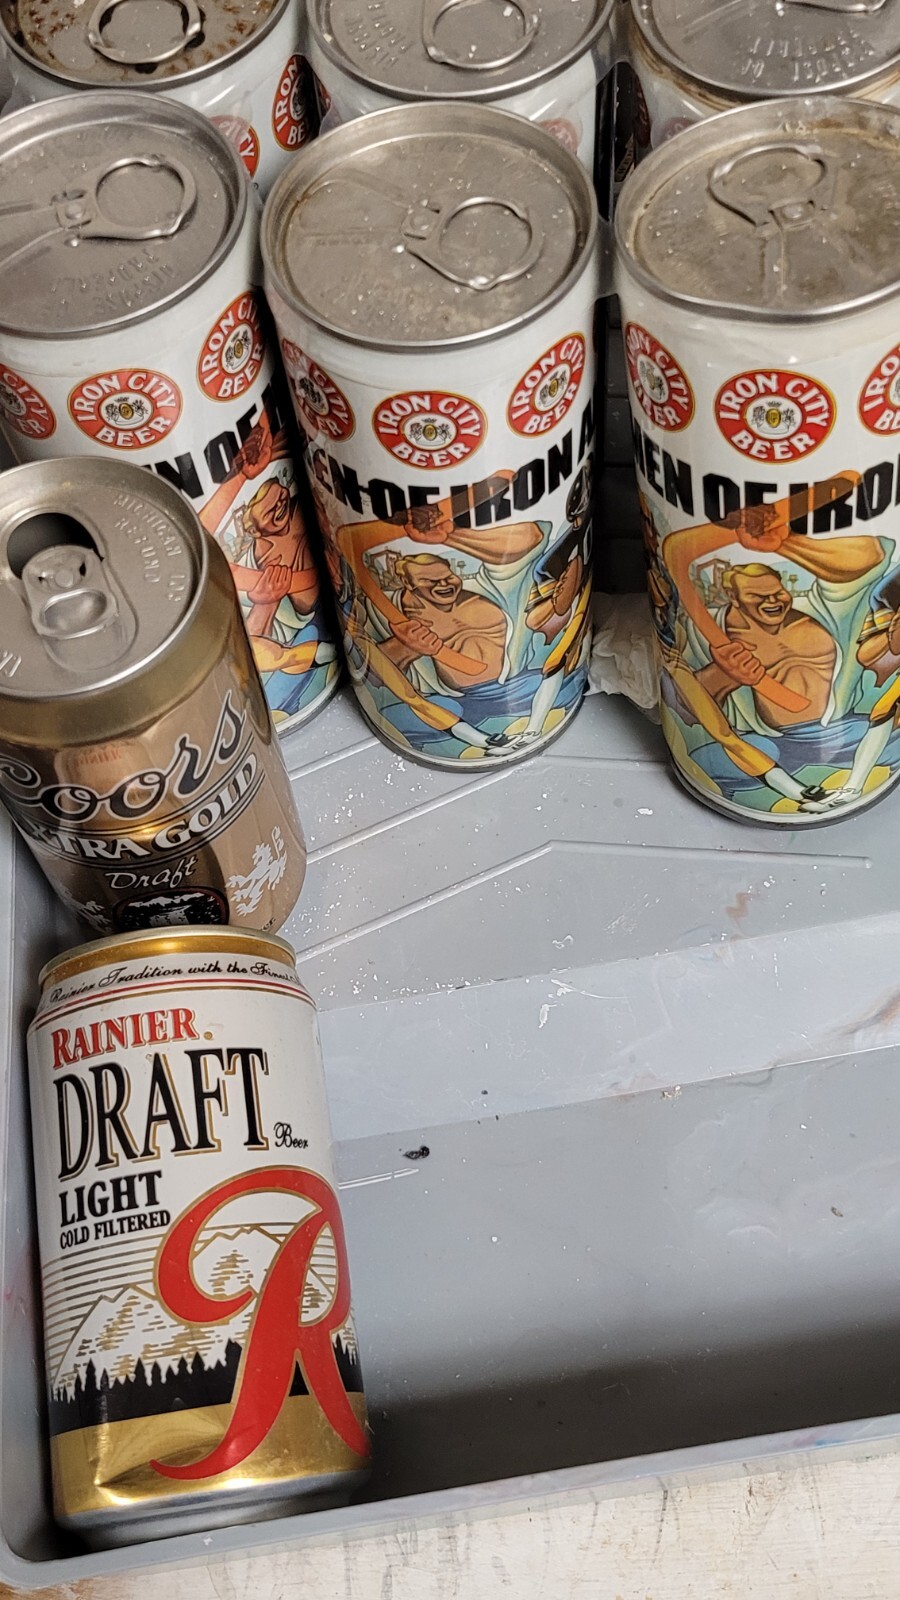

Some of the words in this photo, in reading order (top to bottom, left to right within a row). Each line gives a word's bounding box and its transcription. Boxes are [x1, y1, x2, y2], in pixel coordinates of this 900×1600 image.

[202, 311, 235, 385] IRON
[218, 344, 263, 397] BEER
[3, 372, 49, 421] CITY
[72, 375, 122, 421] IRON
[128, 372, 176, 408] CITY
[314, 370, 349, 425] CITY
[512, 352, 556, 420] IRON
[559, 338, 585, 373] CITY
[633, 380, 681, 426] BEER
[655, 350, 689, 411] CITY
[719, 373, 779, 420] IRON
[785, 377, 830, 427] CITY
[863, 354, 900, 412] IRO
[96, 415, 171, 446] BEER
[377, 395, 431, 436] IRON
[438, 397, 480, 437] CITY
[523, 382, 578, 434] BEER
[874, 409, 900, 431] BE
[204, 403, 257, 484] OF
[392, 441, 471, 467] BEER
[731, 429, 815, 460] BEER
[311, 448, 363, 515] EN
[368, 478, 441, 531] OF
[450, 428, 574, 528] IRON
[633, 416, 694, 517] MEN
[703, 473, 778, 537] OF
[789, 452, 900, 535] IRO
[0, 690, 247, 824] Coors
[26, 814, 150, 860] XTRA
[153, 754, 257, 851] GOLD
[104, 856, 198, 889] Draft
[50, 982, 96, 1002] Rainier
[98, 966, 183, 987] Tradition
[188, 960, 222, 975] with
[226, 960, 248, 974] the
[51, 1007, 200, 1070] RAINIER
[53, 1048, 270, 1182] DRAFT
[273, 1122, 309, 1149] Beer
[58, 1170, 162, 1228] LIGHT
[59, 1230, 90, 1250] COLD
[95, 1209, 171, 1239] FILTERED
